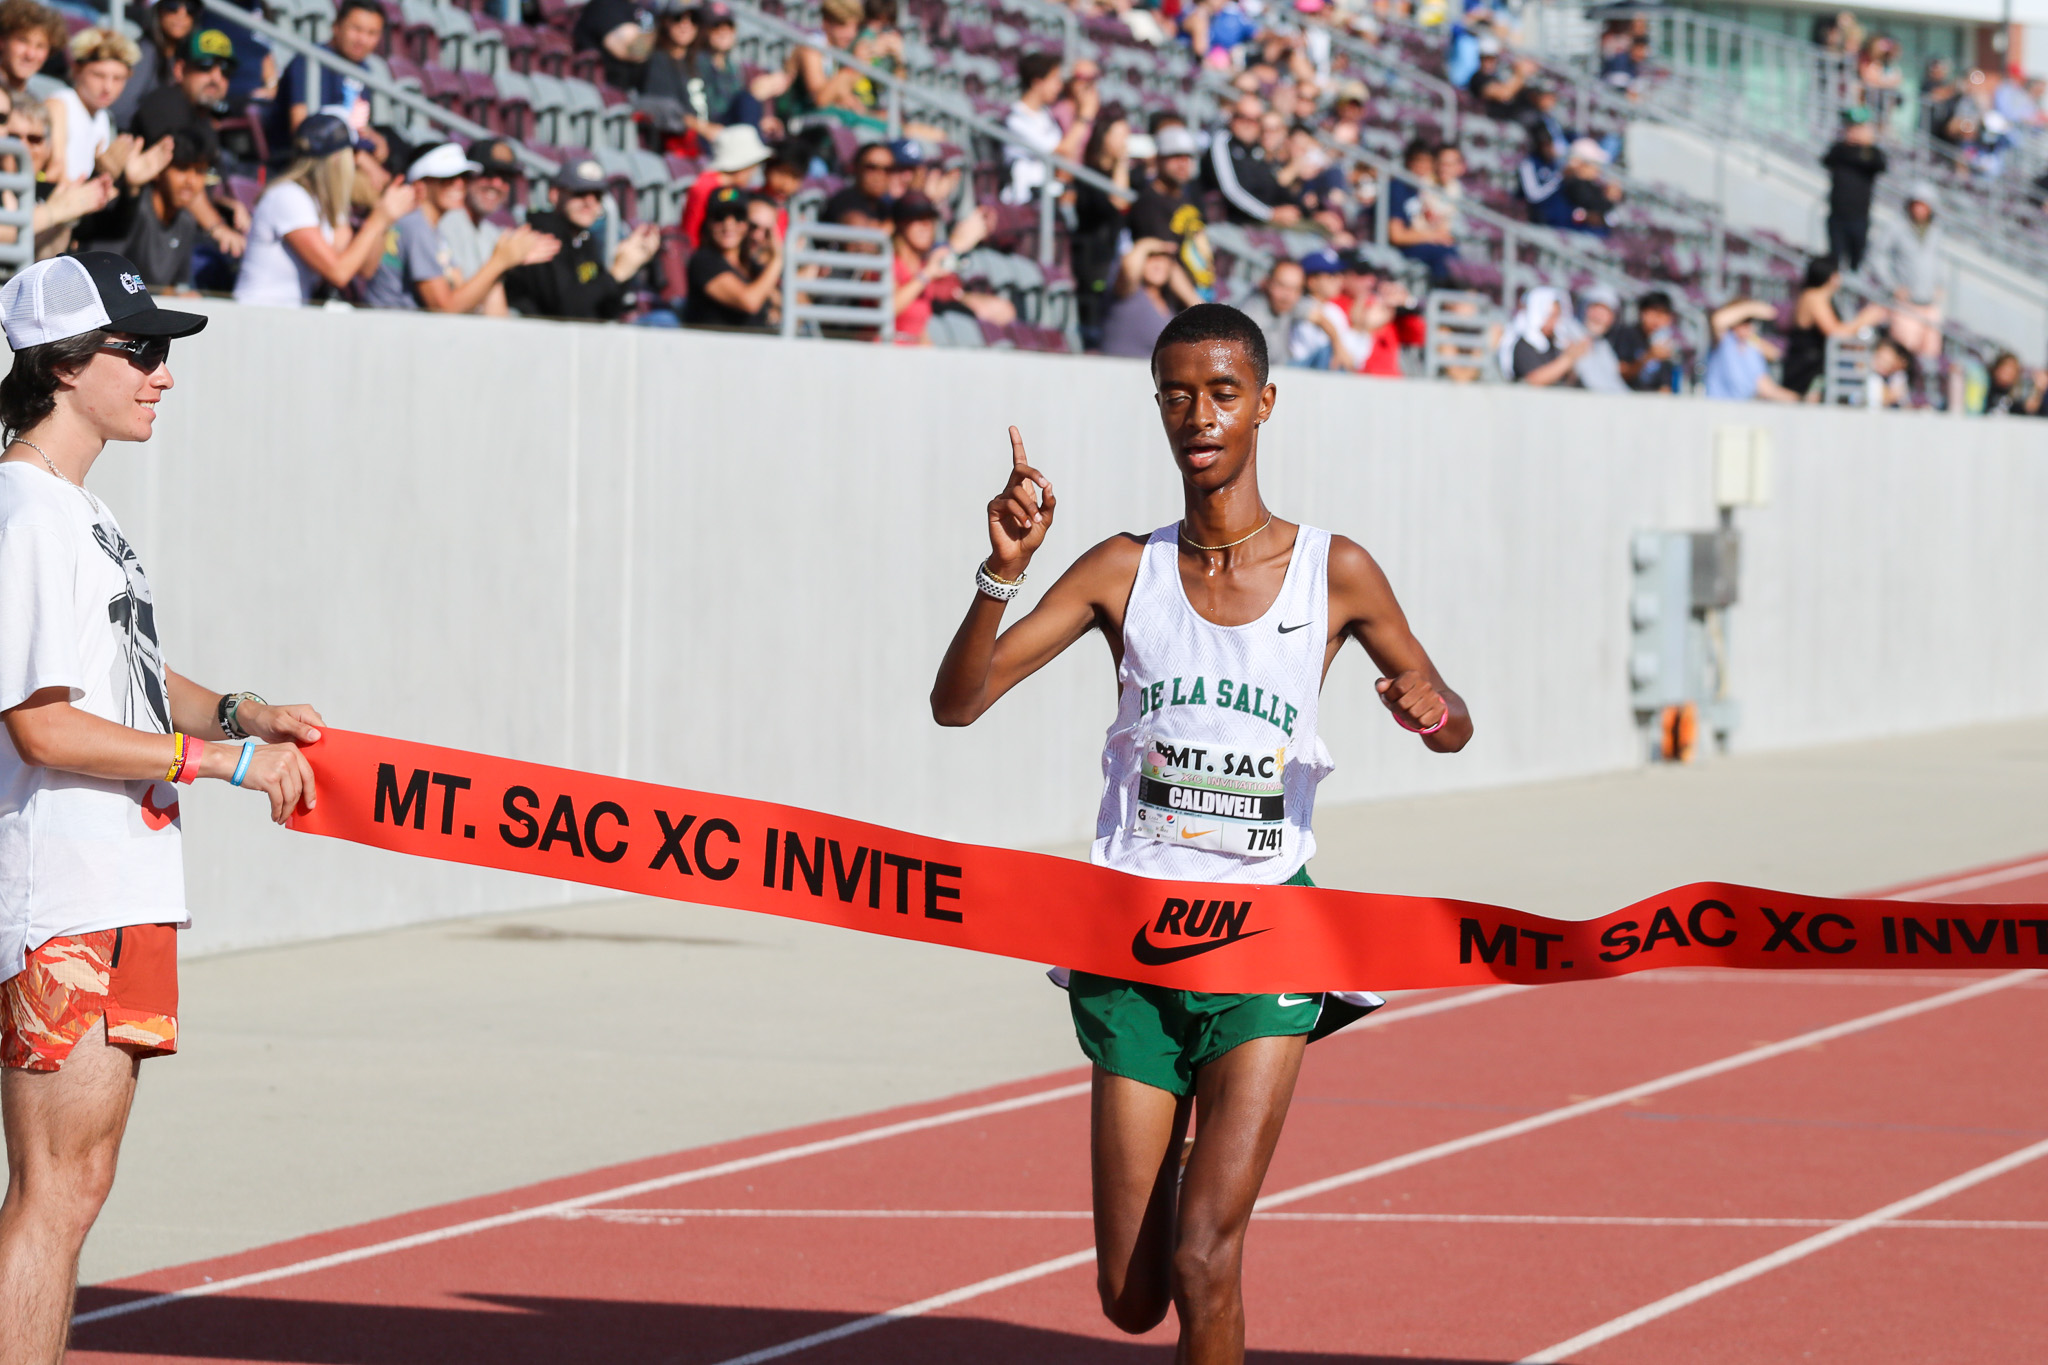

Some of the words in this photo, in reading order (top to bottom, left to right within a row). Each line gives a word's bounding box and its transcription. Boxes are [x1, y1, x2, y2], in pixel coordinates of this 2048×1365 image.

[1140, 680, 1165, 718] DE
[1171, 676, 1206, 706] LA
[1216, 679, 1298, 738] SALLE
[1167, 745, 1214, 773] MT.
[1223, 753, 1275, 778] SAC
[1168, 786, 1263, 819] CALDWELL
[374, 762, 476, 839] MT.
[499, 785, 630, 863] SAC
[648, 809, 741, 881] XC
[763, 827, 963, 923] INVITE
[1247, 828, 1283, 851] 7741
[1153, 898, 1253, 938] RUN
[1459, 917, 1574, 970] MT.
[1599, 899, 1738, 963] SAC
[1759, 907, 1858, 954] XC
